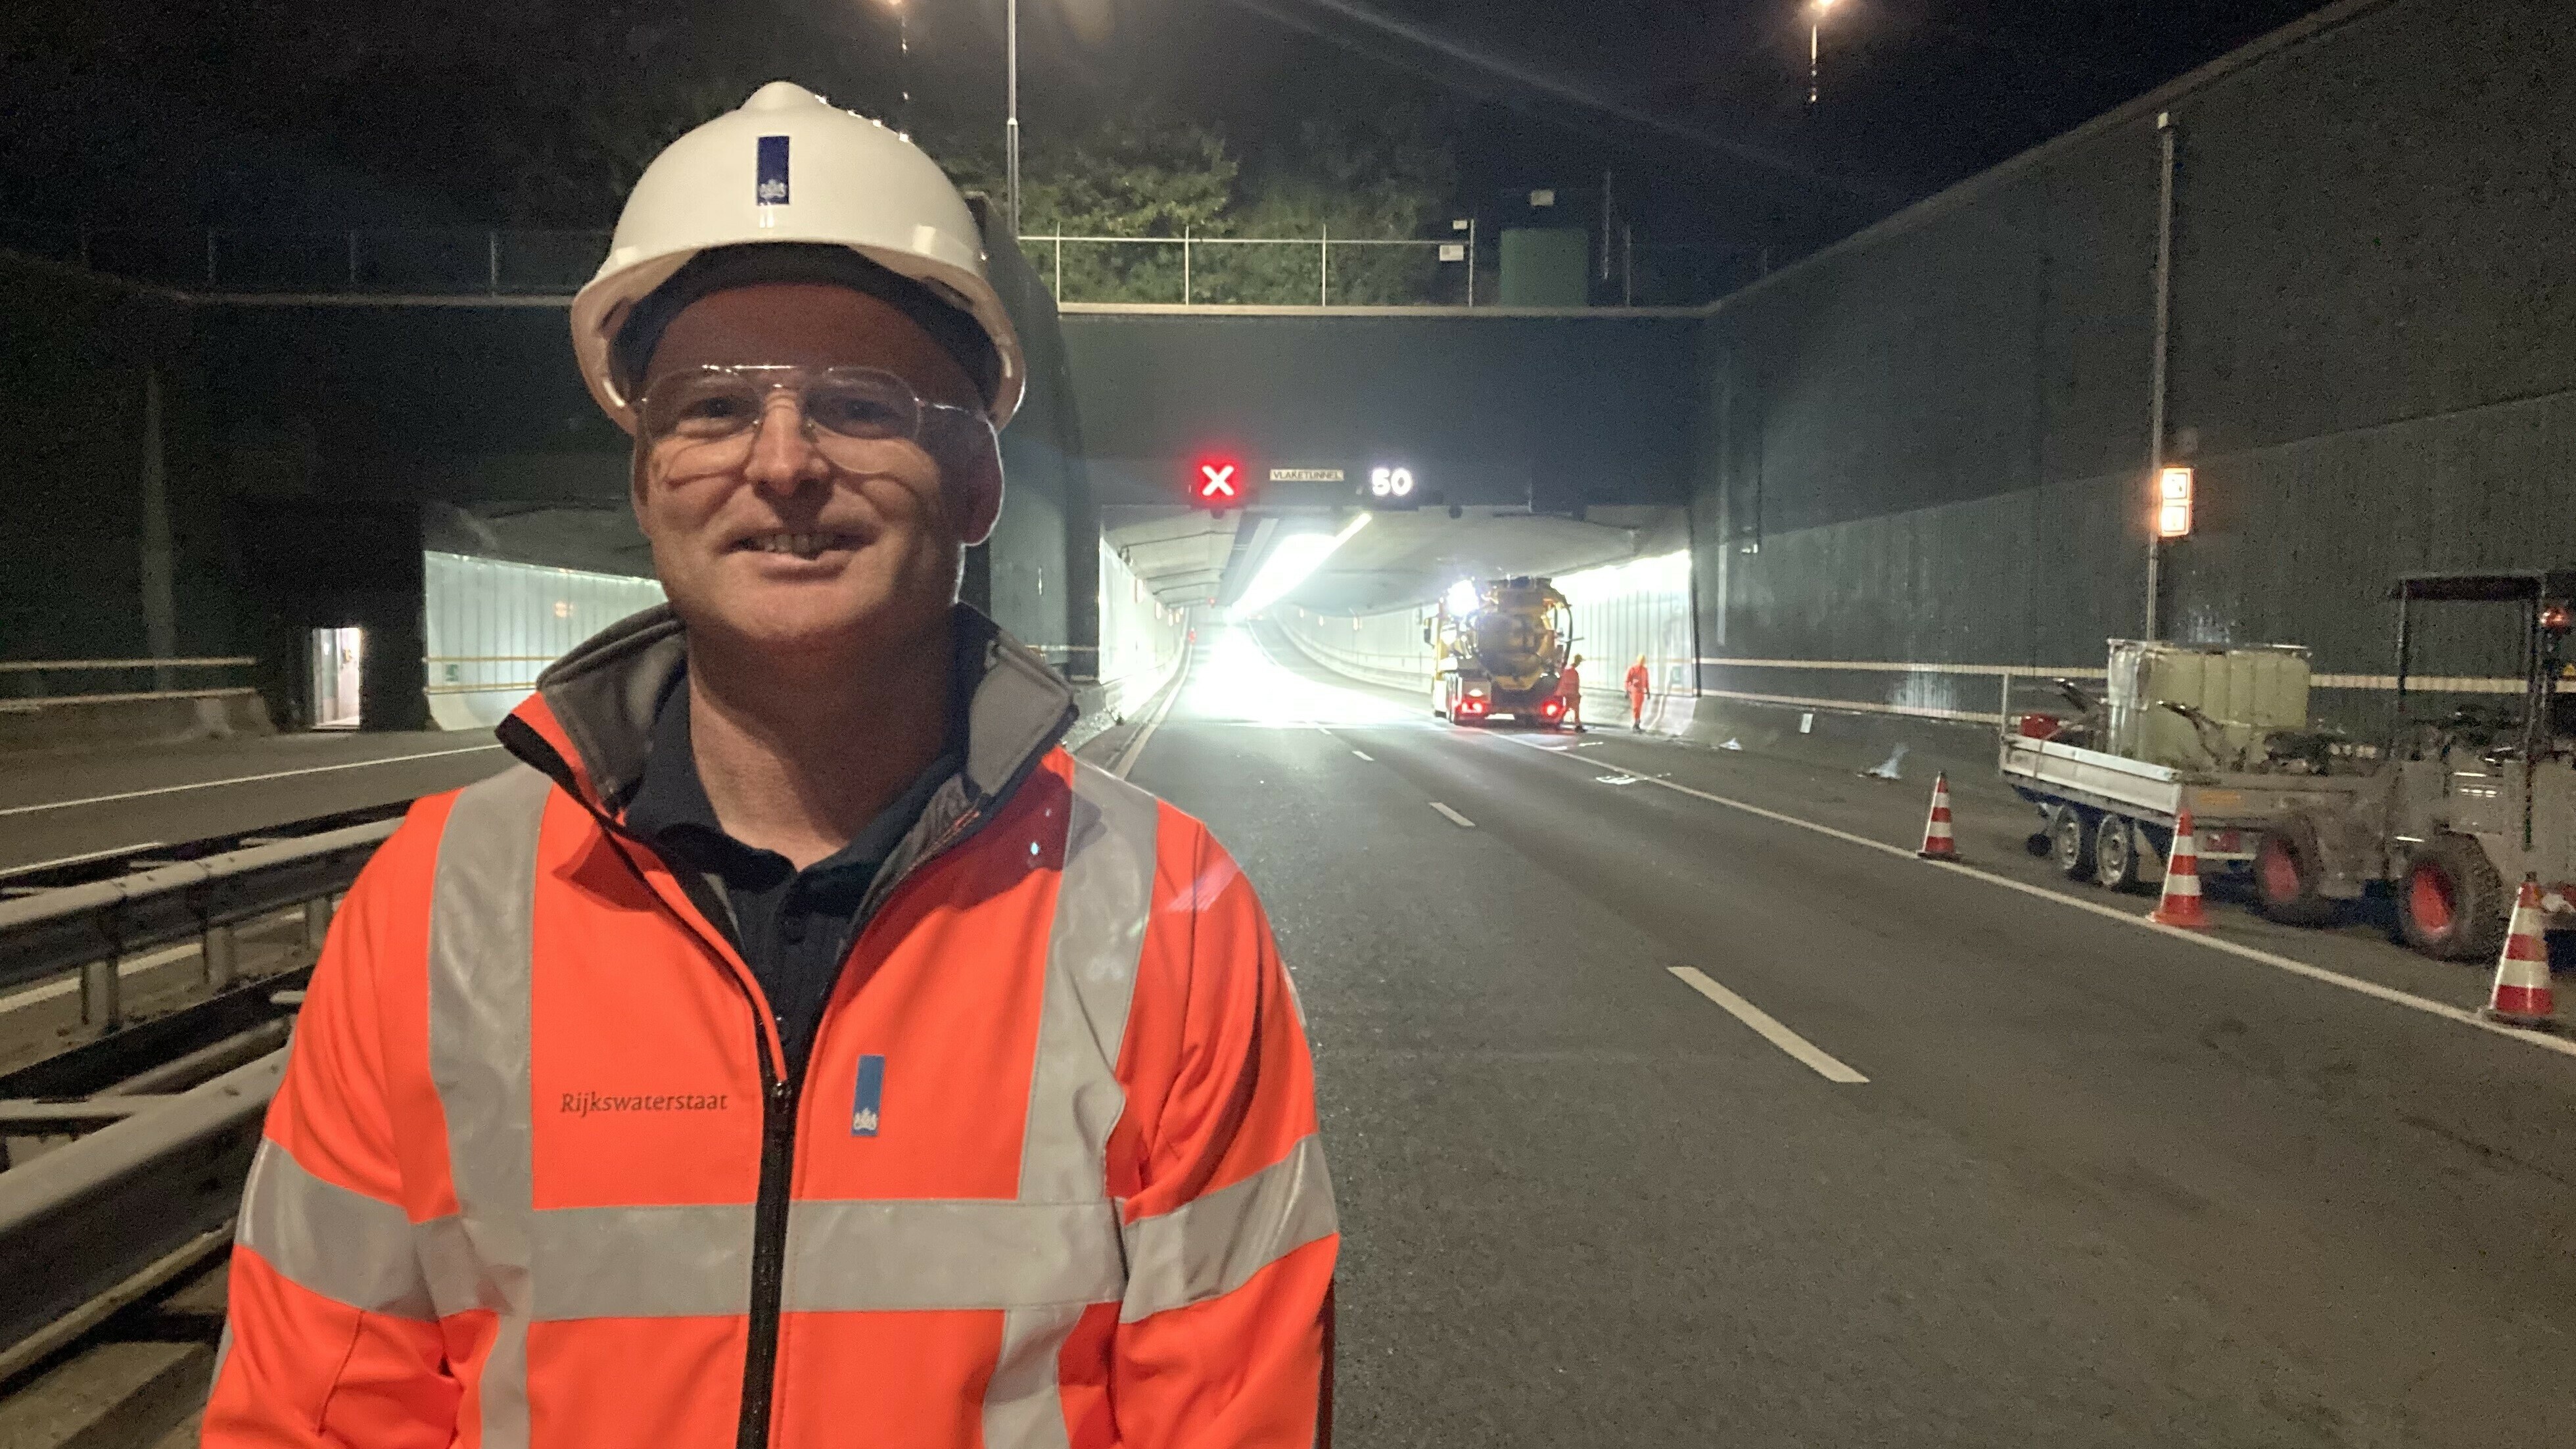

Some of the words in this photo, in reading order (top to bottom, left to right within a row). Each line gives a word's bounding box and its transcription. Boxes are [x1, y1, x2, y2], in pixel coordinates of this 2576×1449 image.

[1273, 471, 1341, 479] VLAKETUNNEL
[1372, 467, 1413, 496] 50
[560, 1091, 728, 1118] Rijkswaterstaat
